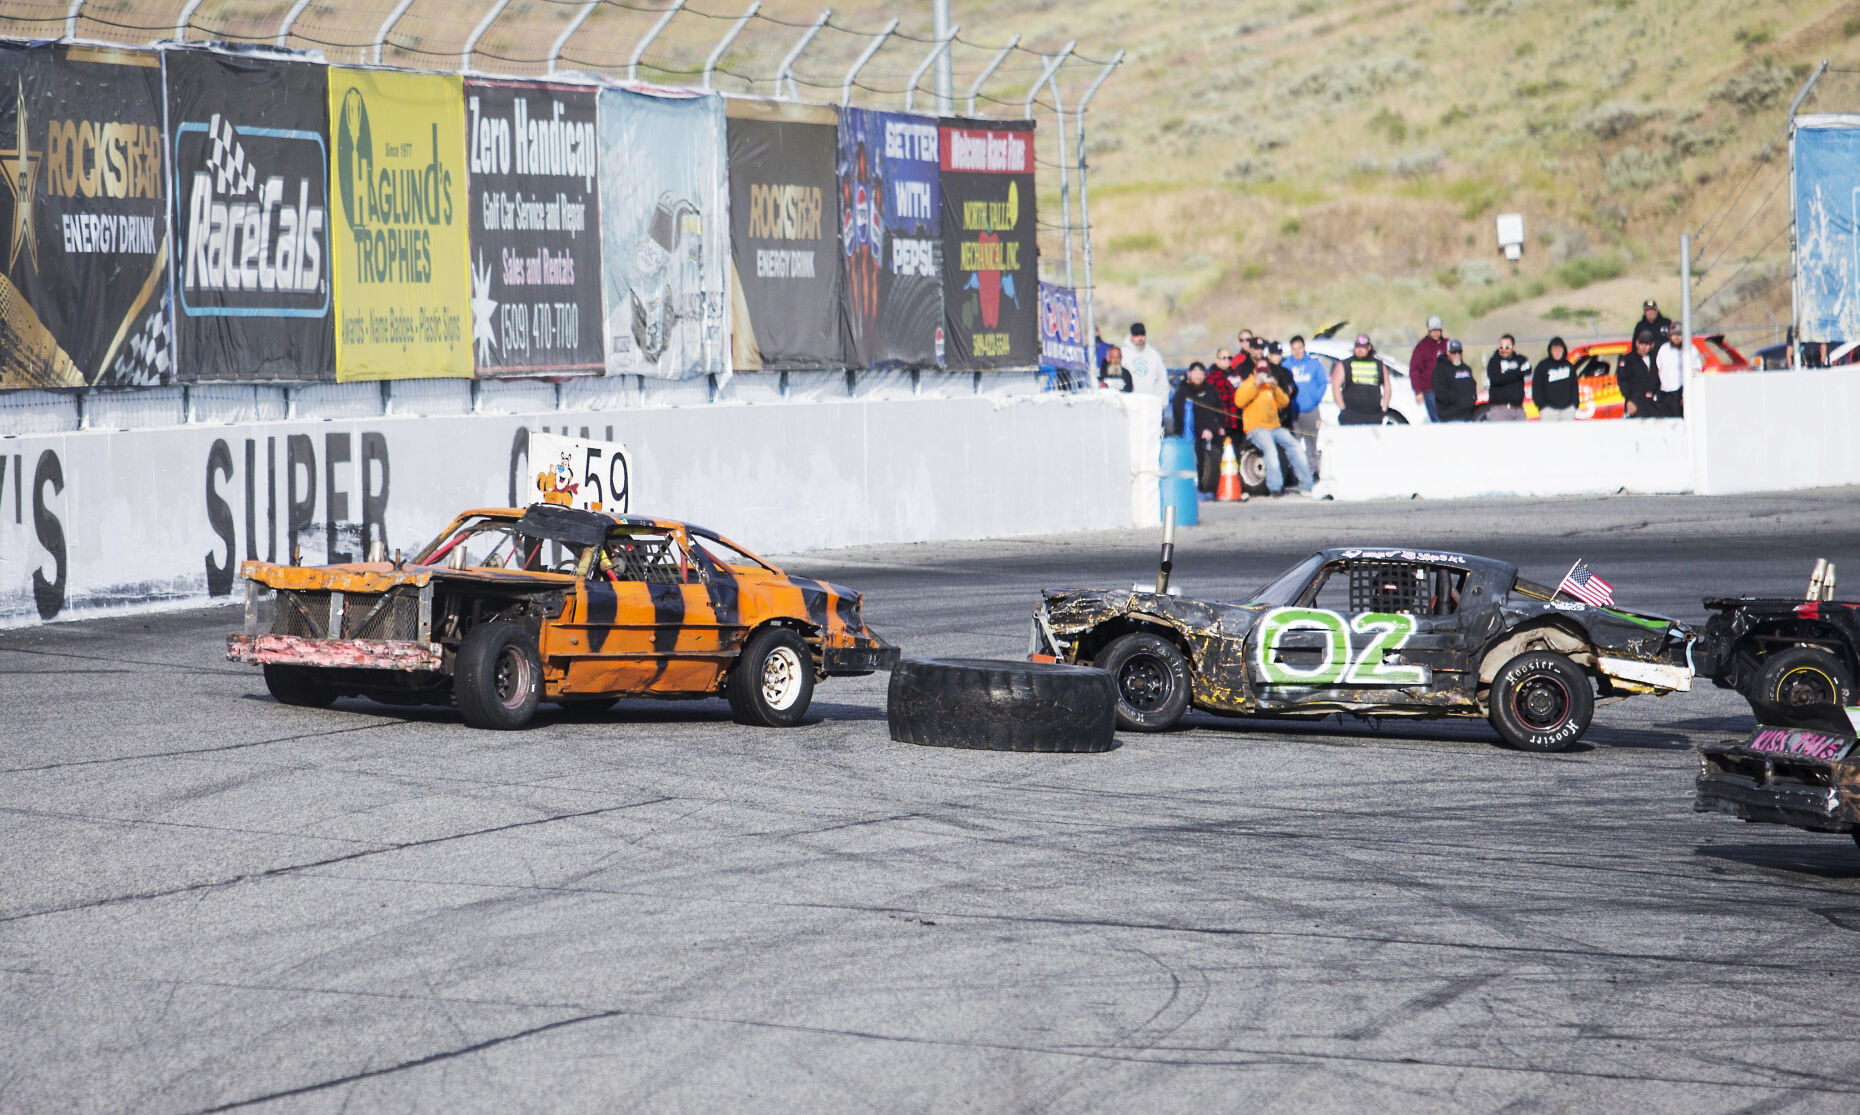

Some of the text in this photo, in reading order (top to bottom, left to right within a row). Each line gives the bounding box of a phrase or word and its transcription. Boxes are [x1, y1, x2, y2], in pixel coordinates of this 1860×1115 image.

[48, 119, 162, 199] ROCKSTAR
[469, 96, 596, 194] Zero Handicap
[885, 121, 939, 163] BETTER
[483, 191, 586, 239] Golf Car Service and Repair
[749, 183, 823, 241] ROCKSTAR
[894, 180, 932, 219] WITH
[62, 213, 157, 254] ENERGY DRINK
[185, 169, 324, 292] RaceCals
[353, 228, 432, 284] TROPHIES
[502, 247, 575, 286] Sales and Rentals
[756, 249, 816, 279] ENERGY DRINK
[501, 303, 530, 359] (509)
[584, 447, 629, 514] 59
[0, 449, 68, 620] 'S
[205, 432, 390, 598] SUPER
[1505, 658, 1554, 686] Hoosier
[1529, 719, 1579, 748] Hoosier
[1750, 729, 1794, 752] KISS
